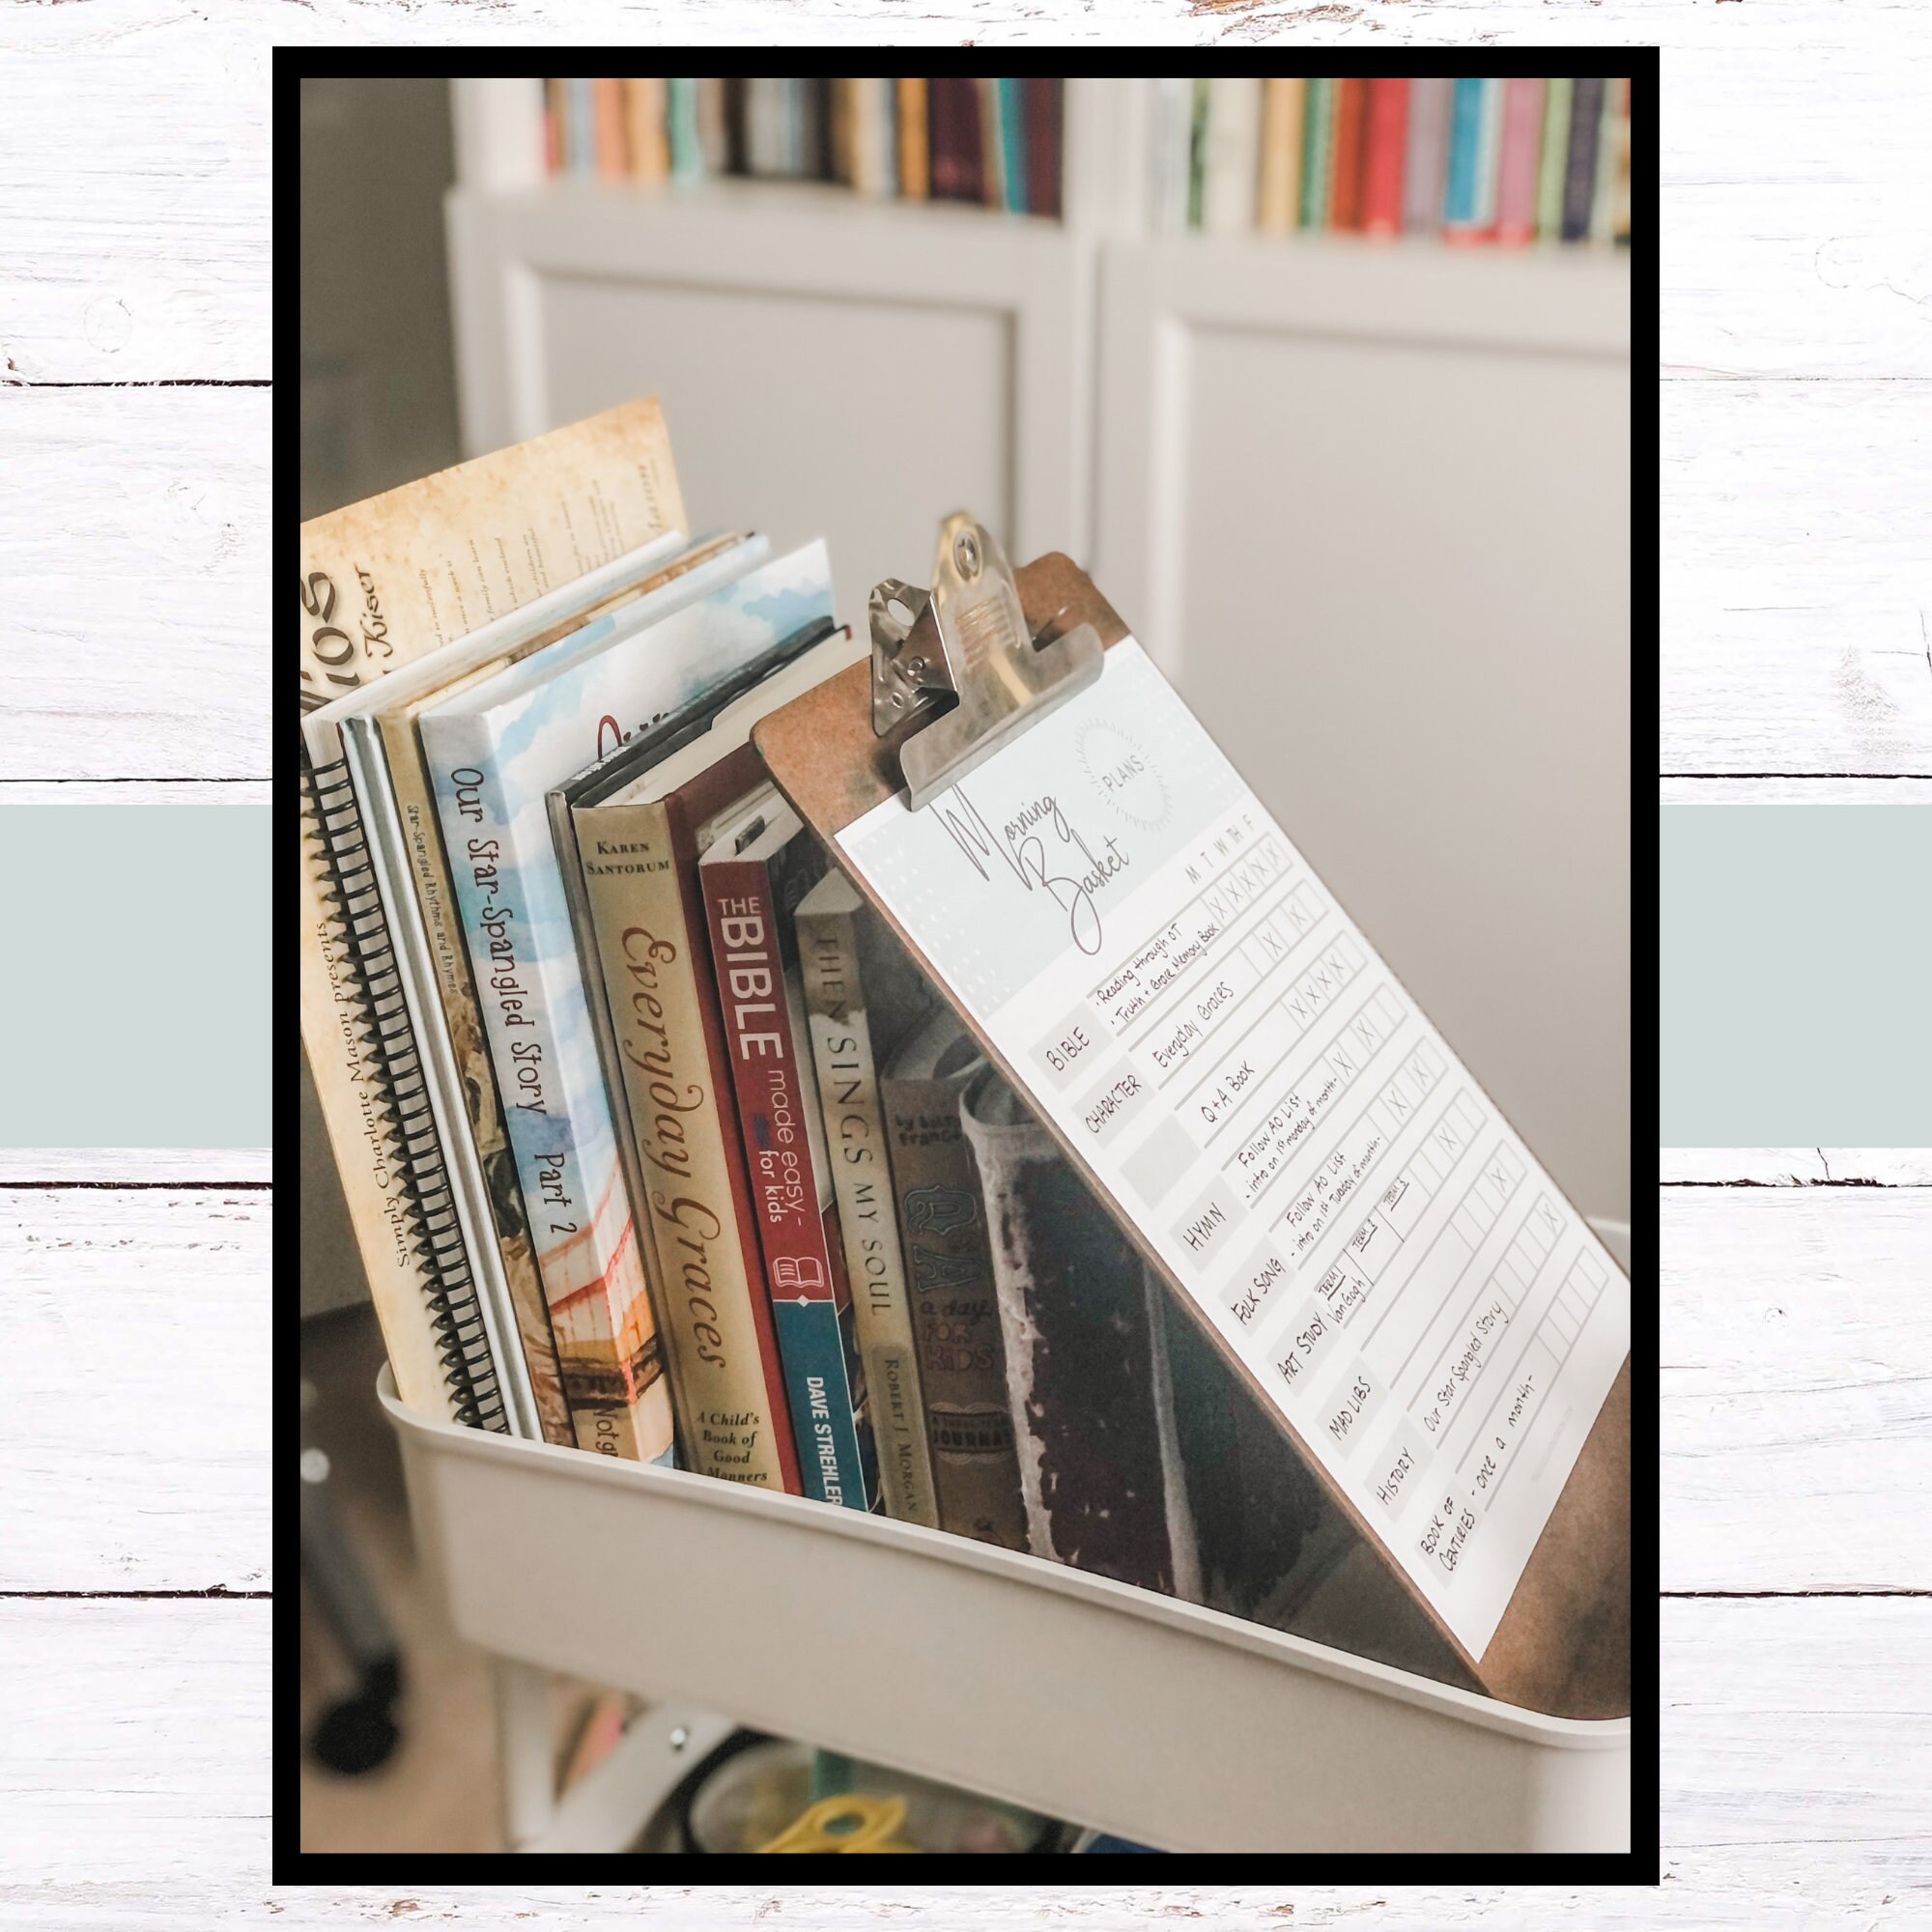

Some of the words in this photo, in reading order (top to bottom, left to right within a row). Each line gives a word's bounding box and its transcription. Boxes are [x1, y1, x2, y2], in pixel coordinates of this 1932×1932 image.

[354, 561, 393, 658] Kiser
[450, 768, 484, 823] Our
[1102, 754, 1145, 793] PLANS
[407, 805, 435, 879] Star-Spangled
[928, 783, 1070, 891] Morning
[1019, 829, 1129, 955] Basket
[1185, 865, 1202, 884] M
[1200, 852, 1213, 867] T
[424, 880, 442, 927] Rhythms
[467, 838, 535, 1027] Star-Spangled
[718, 896, 761, 916] THE
[317, 923, 351, 1003] presents
[436, 932, 447, 951] and
[441, 955, 458, 995] Rhymes
[721, 916, 783, 1061] BIBLE
[816, 939, 848, 1020] THEN
[1097, 969, 1141, 1005] Reading
[1133, 939, 1169, 970] through
[1116, 996, 1146, 1023] Truth
[1151, 968, 1176, 990] Grace
[1172, 940, 1208, 970] Memory
[1198, 923, 1220, 943] Book
[340, 1012, 363, 1082] Mason
[622, 926, 704, 1179] Everyday
[1046, 1026, 1090, 1071] BIBLE
[1152, 1020, 1204, 1068] Everyday
[1197, 981, 1235, 1021] Graces
[510, 1041, 547, 1115] Story
[827, 1037, 873, 1164] SINGS
[1085, 1074, 1142, 1134] CHARACTER
[1226, 1060, 1255, 1092] Book
[768, 1069, 796, 1144] made
[358, 1092, 389, 1188] Charlotte
[758, 1150, 779, 1179] for
[1237, 1131, 1271, 1168] Follow
[534, 1152, 572, 1207] Part
[764, 1185, 788, 1223] kids
[781, 1151, 806, 1212] easy
[853, 1182, 878, 1223] MY
[1245, 1167, 1269, 1193] intro
[1268, 1156, 1280, 1171] on
[1383, 1184, 1401, 1206] TERM
[384, 1197, 410, 1267] Simply
[550, 1222, 578, 1234] 2
[1182, 1202, 1227, 1252] HYMN
[1286, 1192, 1316, 1228] Follow
[1293, 1230, 1315, 1252] intro
[1313, 1218, 1325, 1233] on
[1352, 1227, 1370, 1249] TERM
[652, 1190, 725, 1368] Graces
[862, 1239, 892, 1316] SOUL
[1231, 1288, 1261, 1326] FOLK
[1253, 1258, 1287, 1294] SONG
[1318, 1271, 1338, 1296] TERM
[1277, 1351, 1303, 1384] ART
[1296, 1312, 1328, 1354] STUDY
[1424, 1407, 1442, 1432] Our
[1436, 1378, 1458, 1406] Star
[1451, 1331, 1483, 1381] Spangled
[1476, 1300, 1509, 1334] Story
[696, 1411, 706, 1423] A
[710, 1412, 760, 1426] Child's
[806, 1377, 829, 1419] DAVE
[1329, 1410, 1352, 1441] MAD
[1347, 1376, 1371, 1413] LIBS
[703, 1431, 736, 1445] Book
[742, 1431, 758, 1447] of
[714, 1451, 751, 1464] Good
[814, 1424, 843, 1505] STREHLER
[1476, 1455, 1496, 1489] once
[1495, 1436, 1507, 1450] a
[707, 1466, 768, 1482] Manners
[1377, 1446, 1415, 1506] HISTORY
[1420, 1515, 1445, 1555] BOOK
[1444, 1496, 1455, 1515] OF
[1438, 1508, 1476, 1572] CENTURIES
